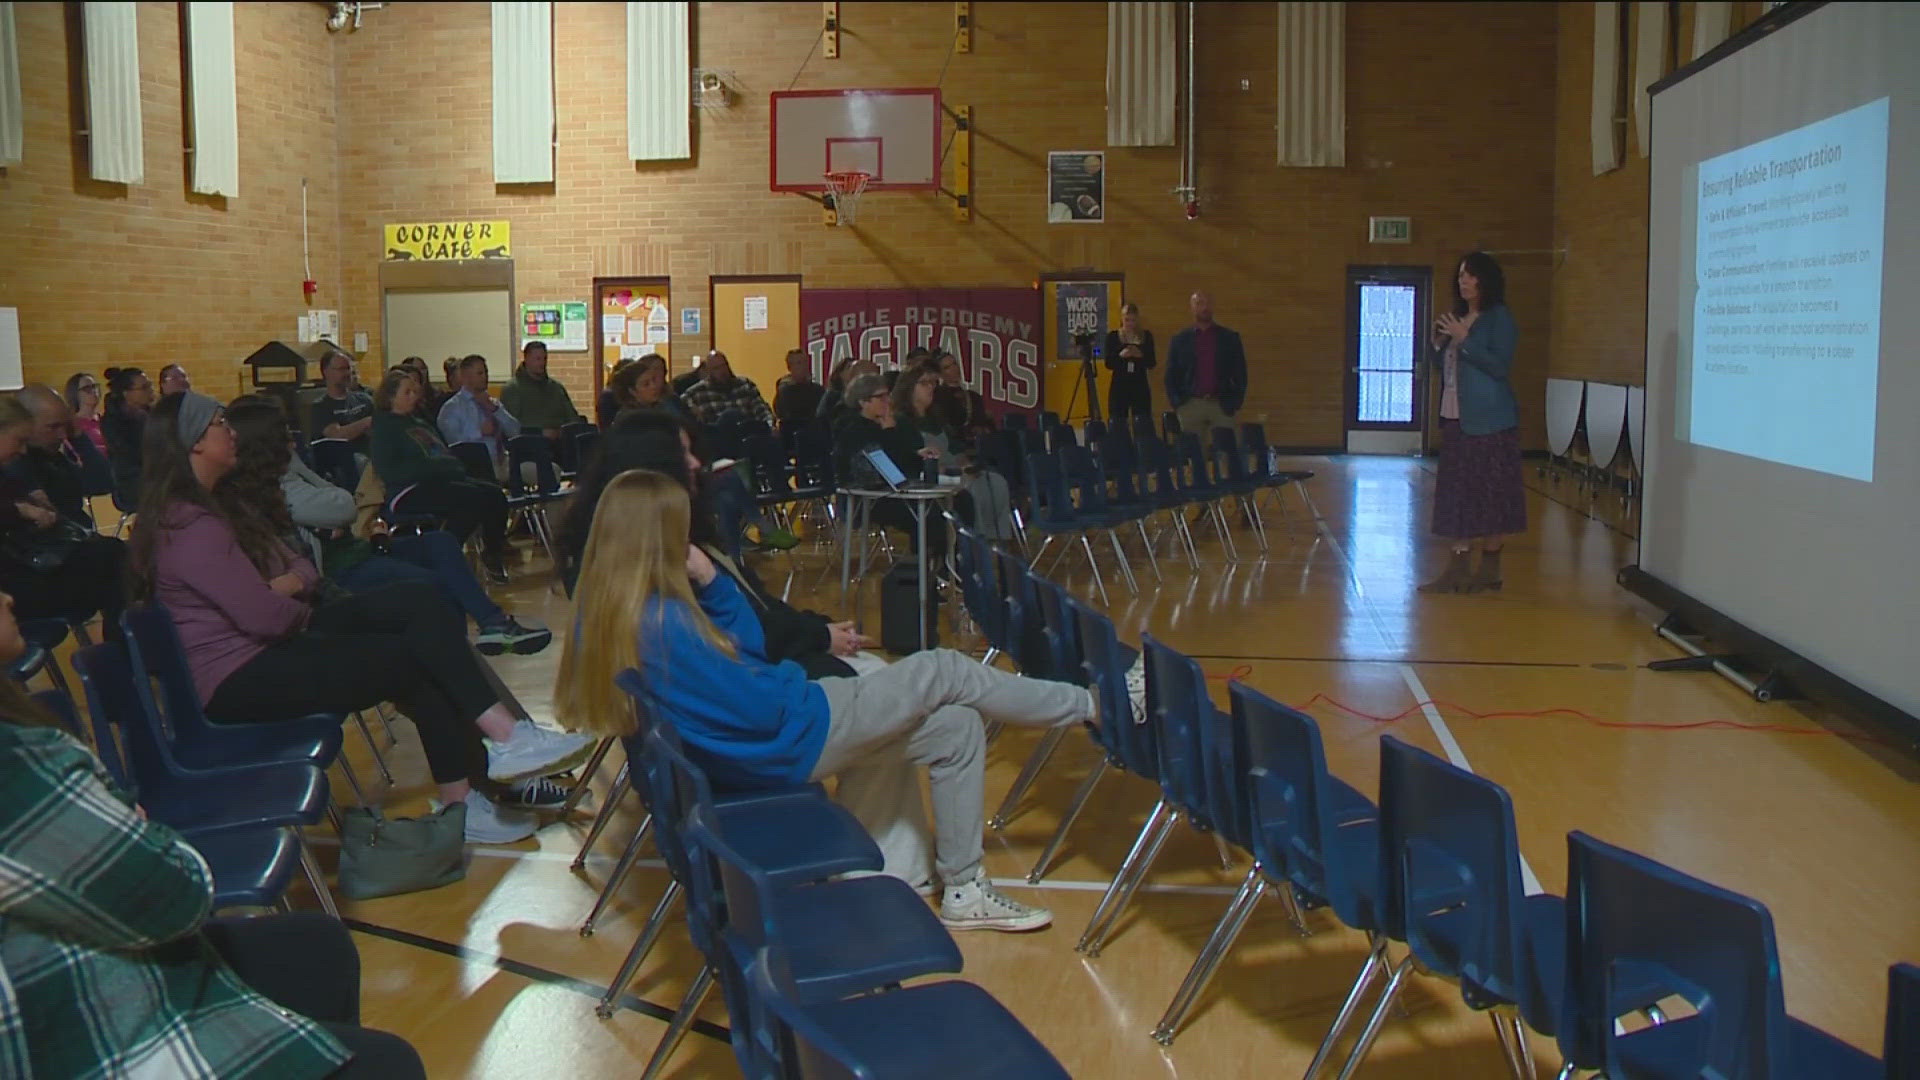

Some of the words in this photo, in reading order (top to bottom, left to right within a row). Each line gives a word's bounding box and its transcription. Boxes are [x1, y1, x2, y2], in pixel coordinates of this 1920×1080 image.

[1702, 176, 1734, 198] Ensuring
[1735, 163, 1768, 189] Reliable
[1769, 144, 1842, 180] Transportation
[396, 222, 492, 244] CORNER
[422, 241, 473, 259] CAFE
[1066, 297, 1097, 312] WORK
[807, 308, 890, 340] EAGLE
[905, 307, 1032, 340] ACADEMY
[1067, 312, 1097, 328] HARD
[808, 325, 1039, 409] JAGUARS
